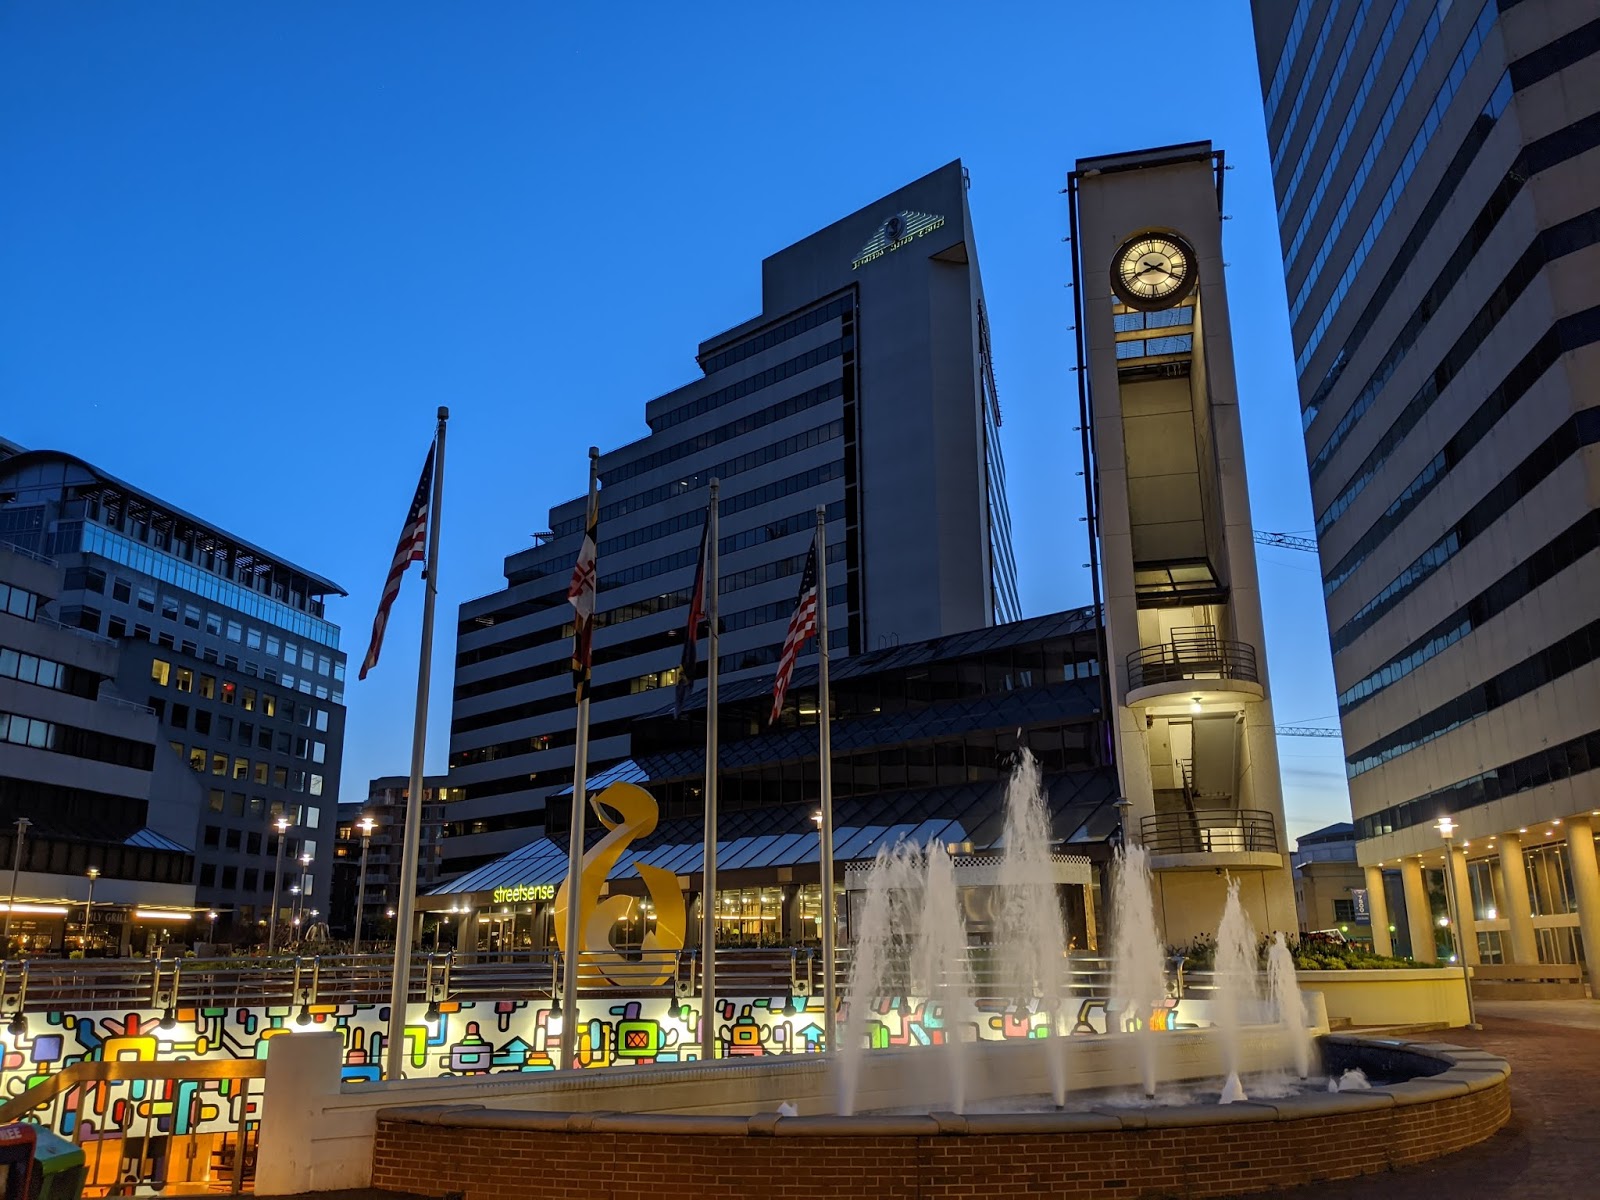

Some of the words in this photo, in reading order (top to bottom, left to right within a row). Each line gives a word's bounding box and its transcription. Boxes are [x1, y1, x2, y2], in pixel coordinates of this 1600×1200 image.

[493, 884, 555, 904] streetsense
[77, 911, 103, 922] DILY
[104, 912, 129, 923] GRILL
